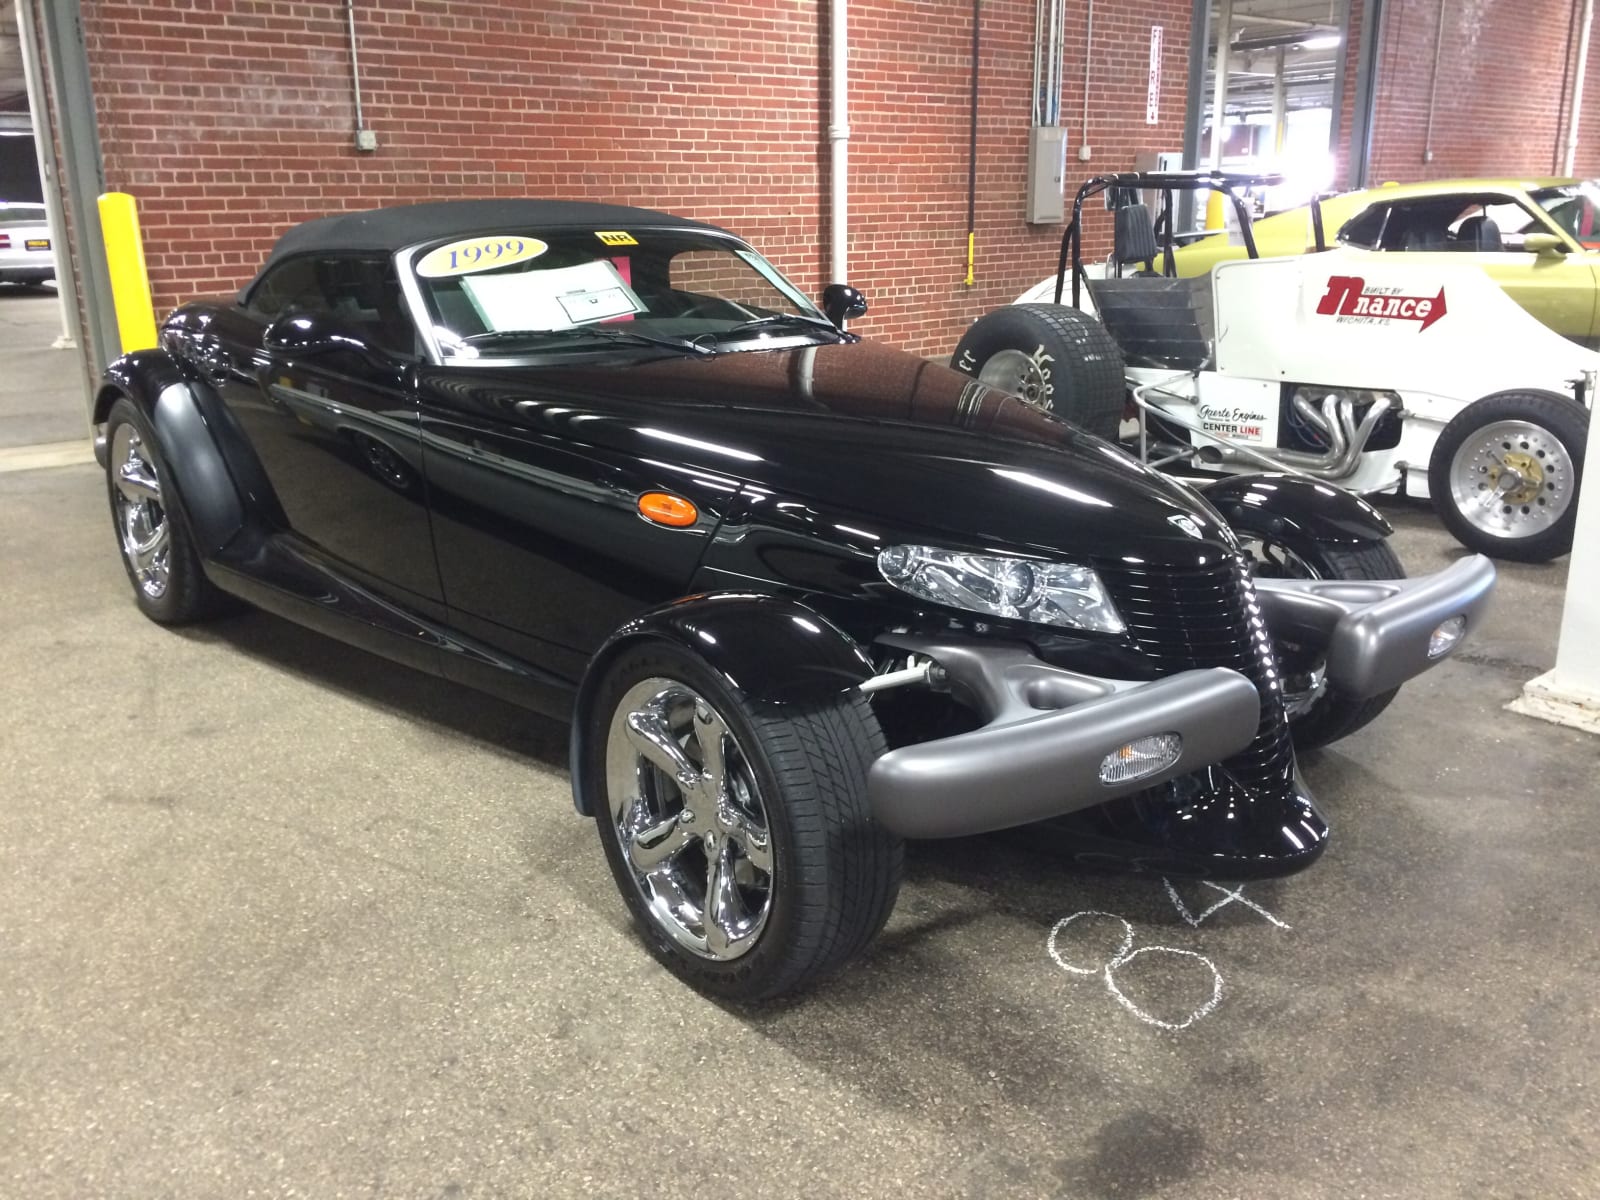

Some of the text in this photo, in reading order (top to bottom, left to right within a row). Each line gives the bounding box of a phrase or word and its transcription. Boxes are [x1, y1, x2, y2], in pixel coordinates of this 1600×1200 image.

[450, 240, 524, 269] 1999
[1364, 286, 1403, 295] BUILT BY
[1232, 408, 1267, 422] Engines
[1203, 422, 1260, 435] CENTER LINE
